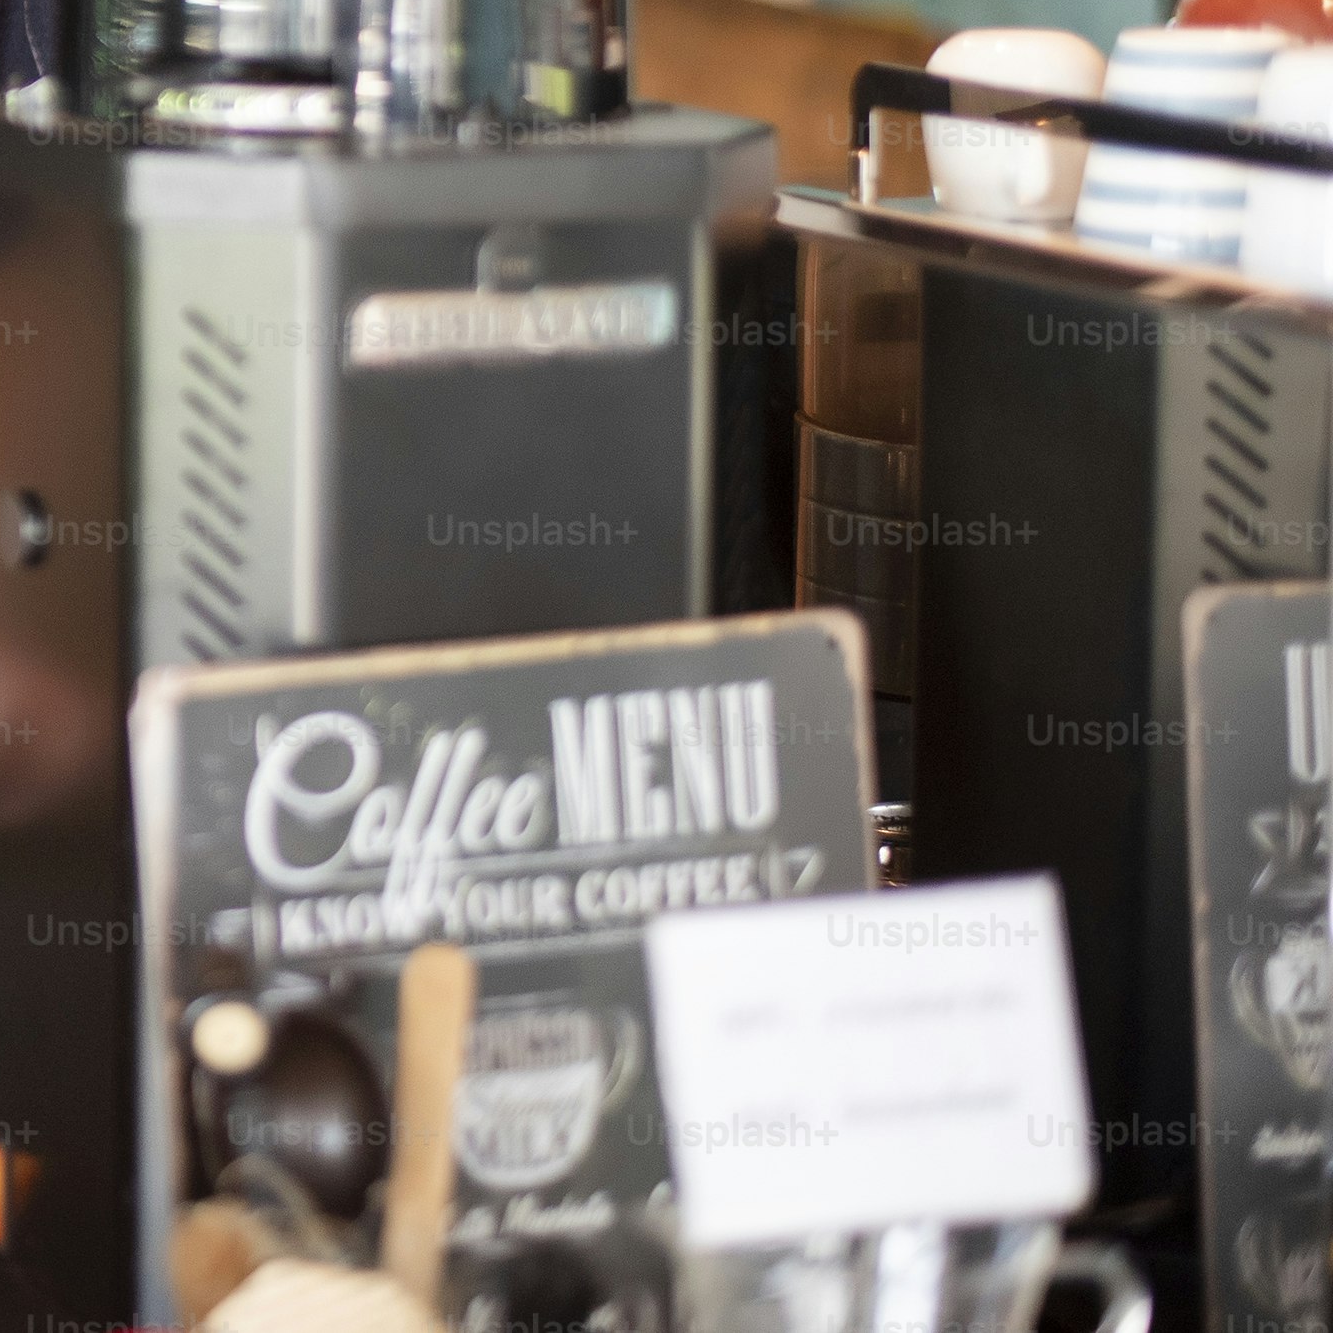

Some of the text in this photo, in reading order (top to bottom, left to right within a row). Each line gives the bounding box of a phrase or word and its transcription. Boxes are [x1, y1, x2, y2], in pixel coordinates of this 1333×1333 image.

[244, 678, 780, 928] Coffee MENU
[574, 851, 761, 922] COFFEE
